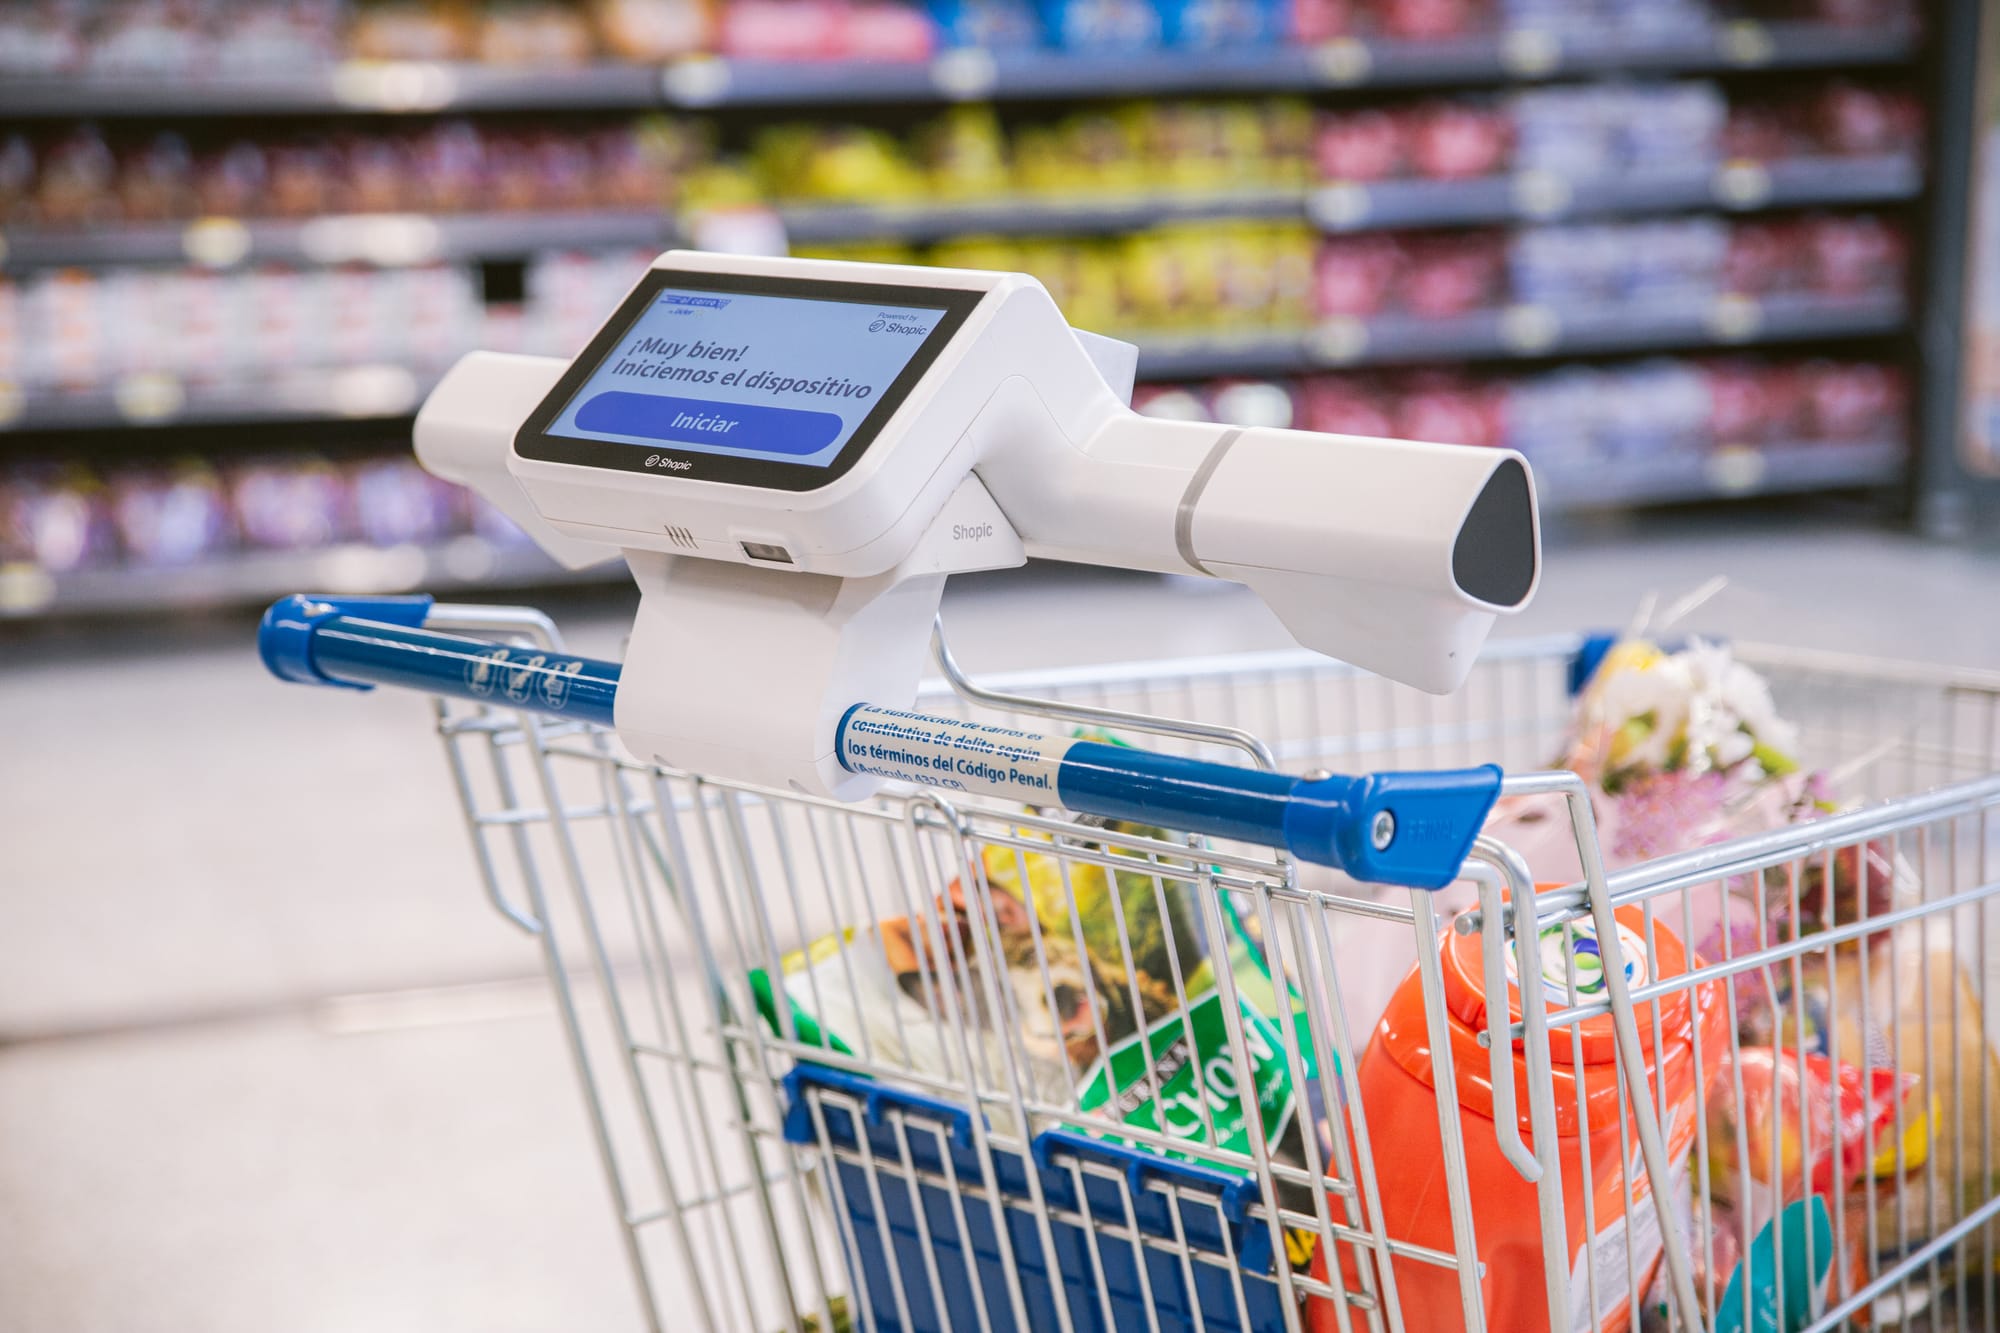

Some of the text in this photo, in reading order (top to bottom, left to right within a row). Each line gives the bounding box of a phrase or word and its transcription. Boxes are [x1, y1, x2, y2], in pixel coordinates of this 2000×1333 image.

[878, 311, 919, 322] Powered by
[886, 322, 927, 336] Shopic
[627, 337, 750, 362] ¡Muy bien!
[611, 358, 872, 399] Iniciemos el dispositivo
[670, 411, 739, 433] Iniciar
[658, 457, 692, 471] Shopic
[952, 522, 993, 542] Shopic
[864, 705, 882, 713] La
[961, 722, 980, 730] de
[981, 725, 1025, 738] carros
[1027, 733, 1044, 741] es
[851, 720, 1041, 763] constitutiva de delito según
[848, 738, 1053, 790] los términos del Código Penal.
